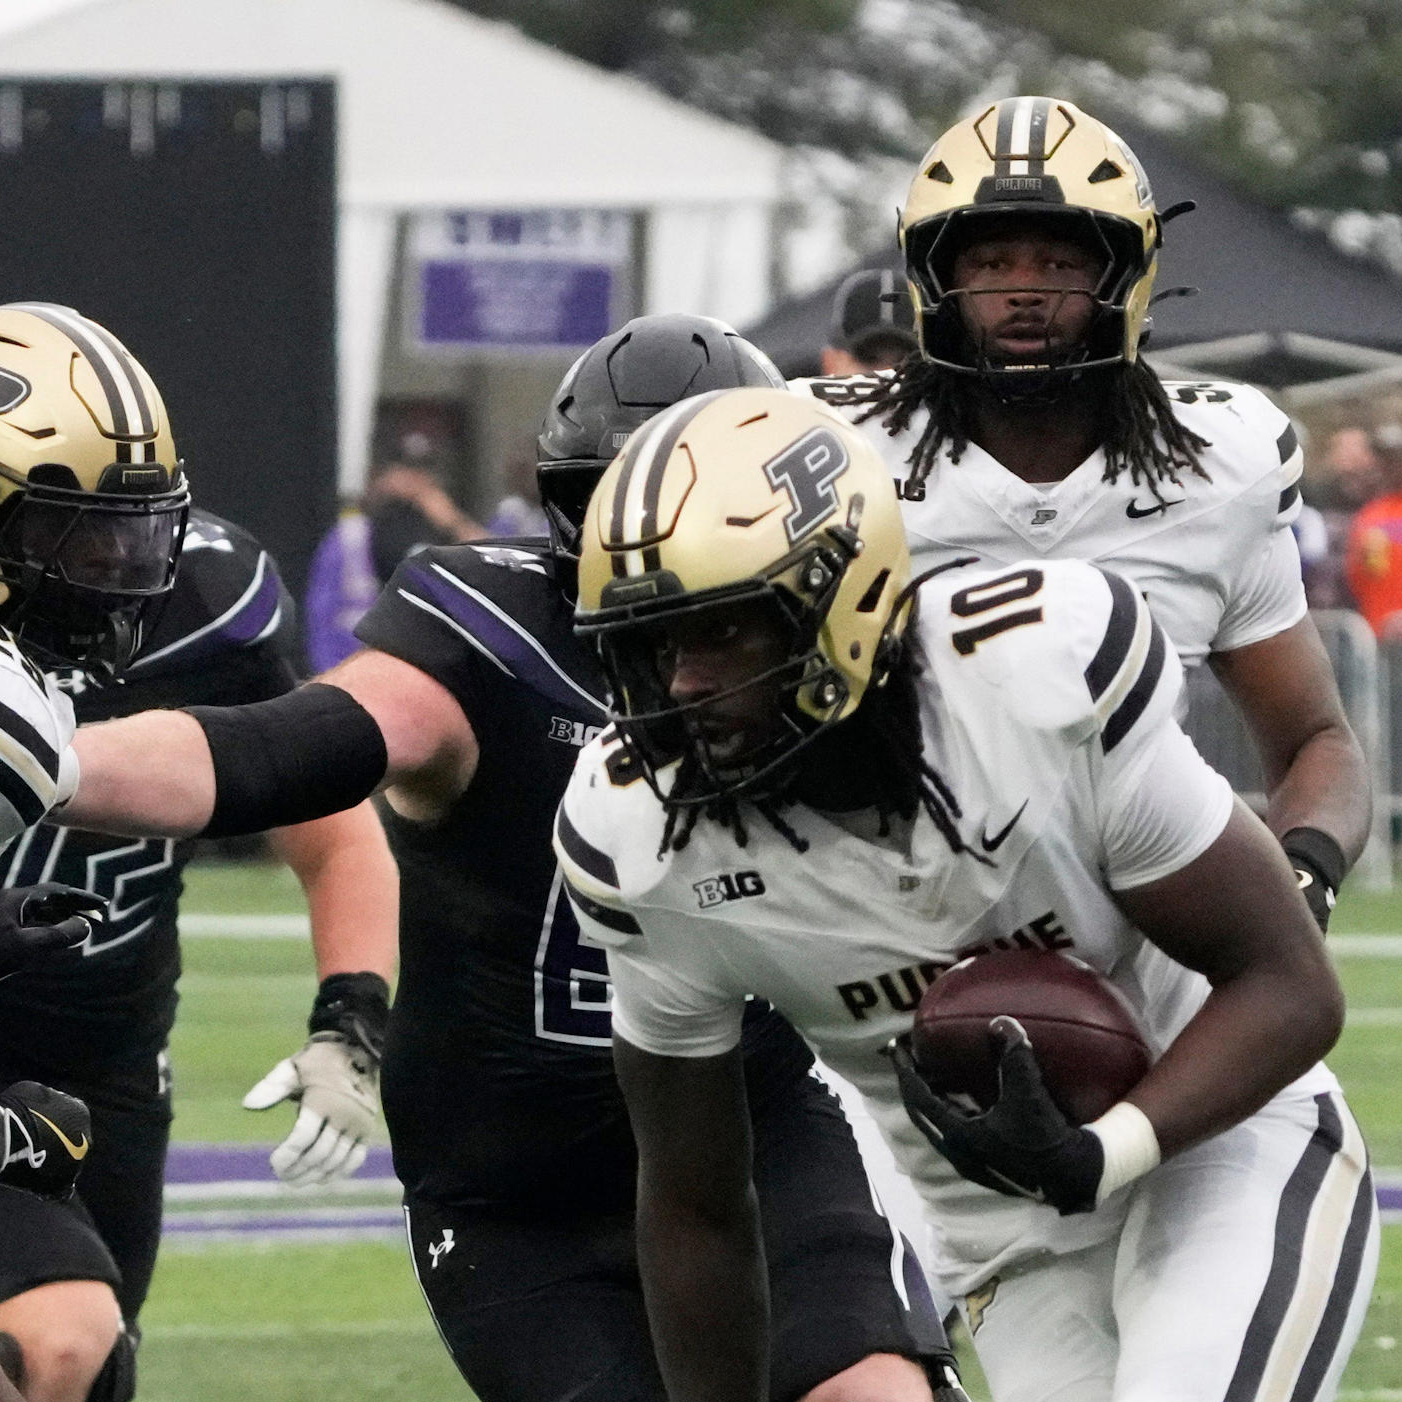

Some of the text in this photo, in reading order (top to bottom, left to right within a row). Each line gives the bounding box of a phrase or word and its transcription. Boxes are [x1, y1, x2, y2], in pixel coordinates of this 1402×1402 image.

[762, 424, 850, 549] P
[949, 567, 1045, 657] 10
[836, 909, 1076, 1021] PUE
